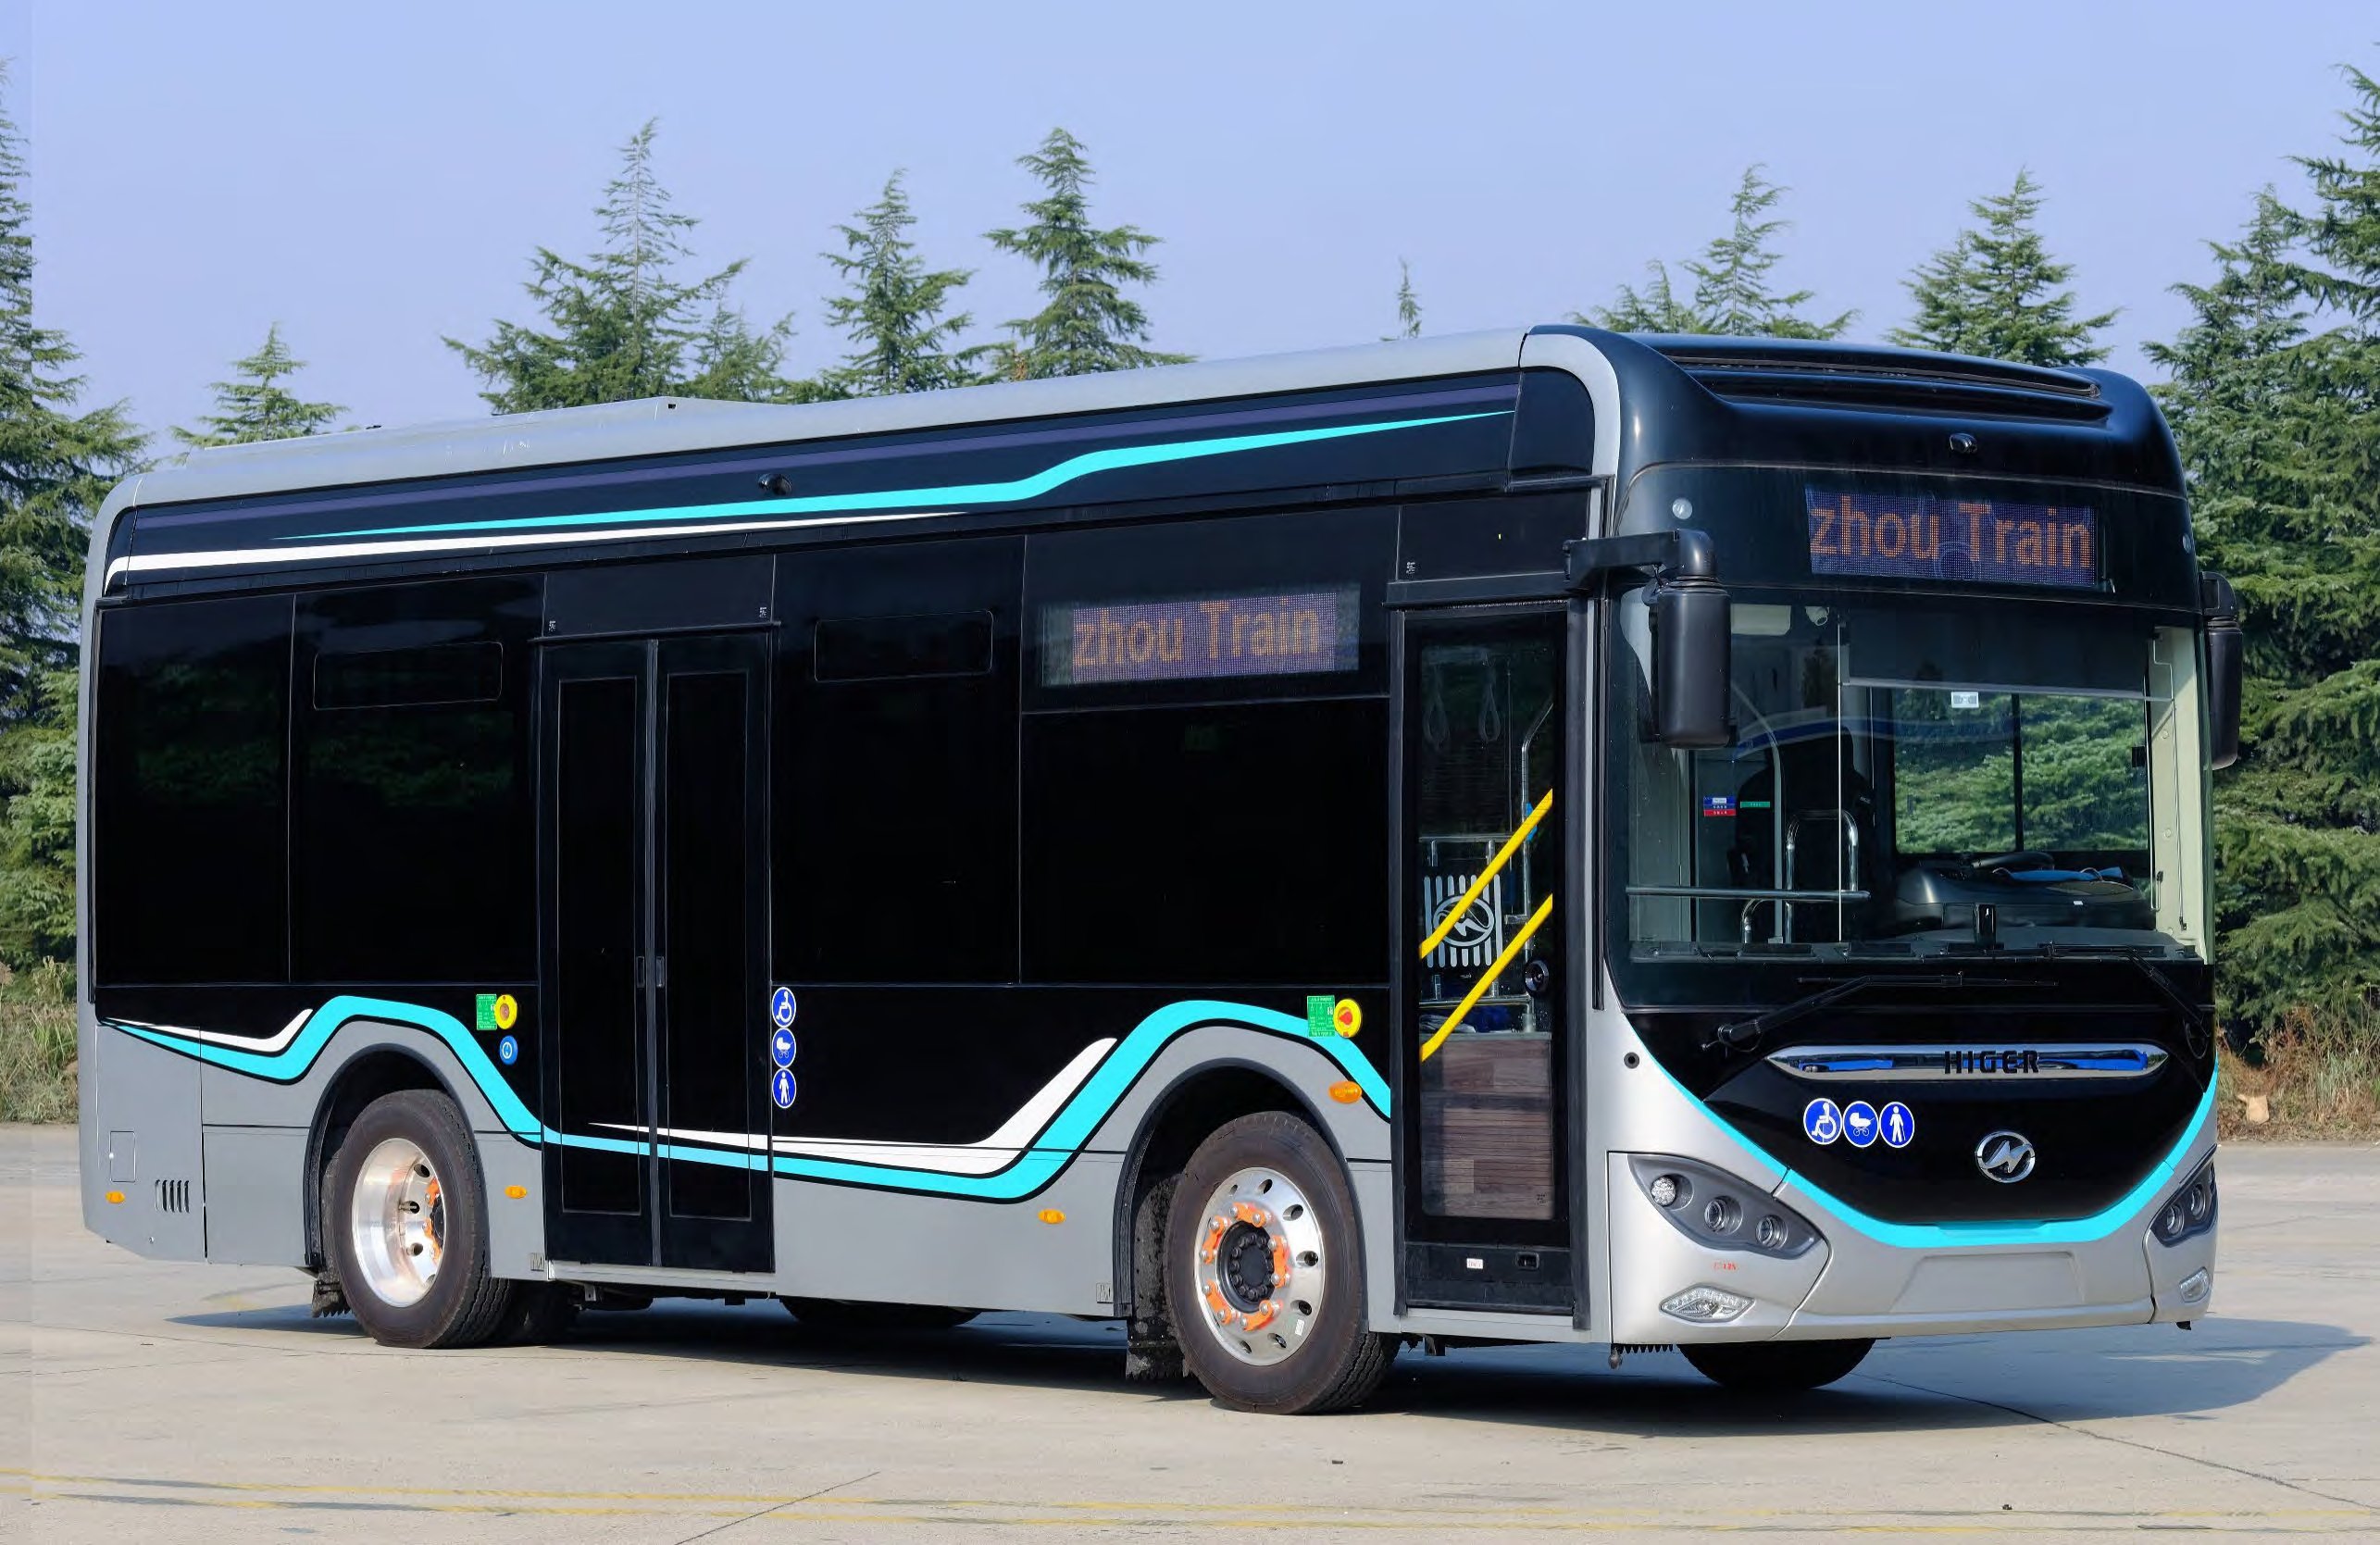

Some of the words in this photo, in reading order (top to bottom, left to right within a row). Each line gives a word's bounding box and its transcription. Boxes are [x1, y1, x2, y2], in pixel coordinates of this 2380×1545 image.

[1810, 494, 1939, 560] zhou
[1956, 502, 2092, 568] Train
[1072, 608, 1185, 667] zhou
[1200, 596, 1320, 660] Train
[1944, 1050, 2039, 1074] HIGER
